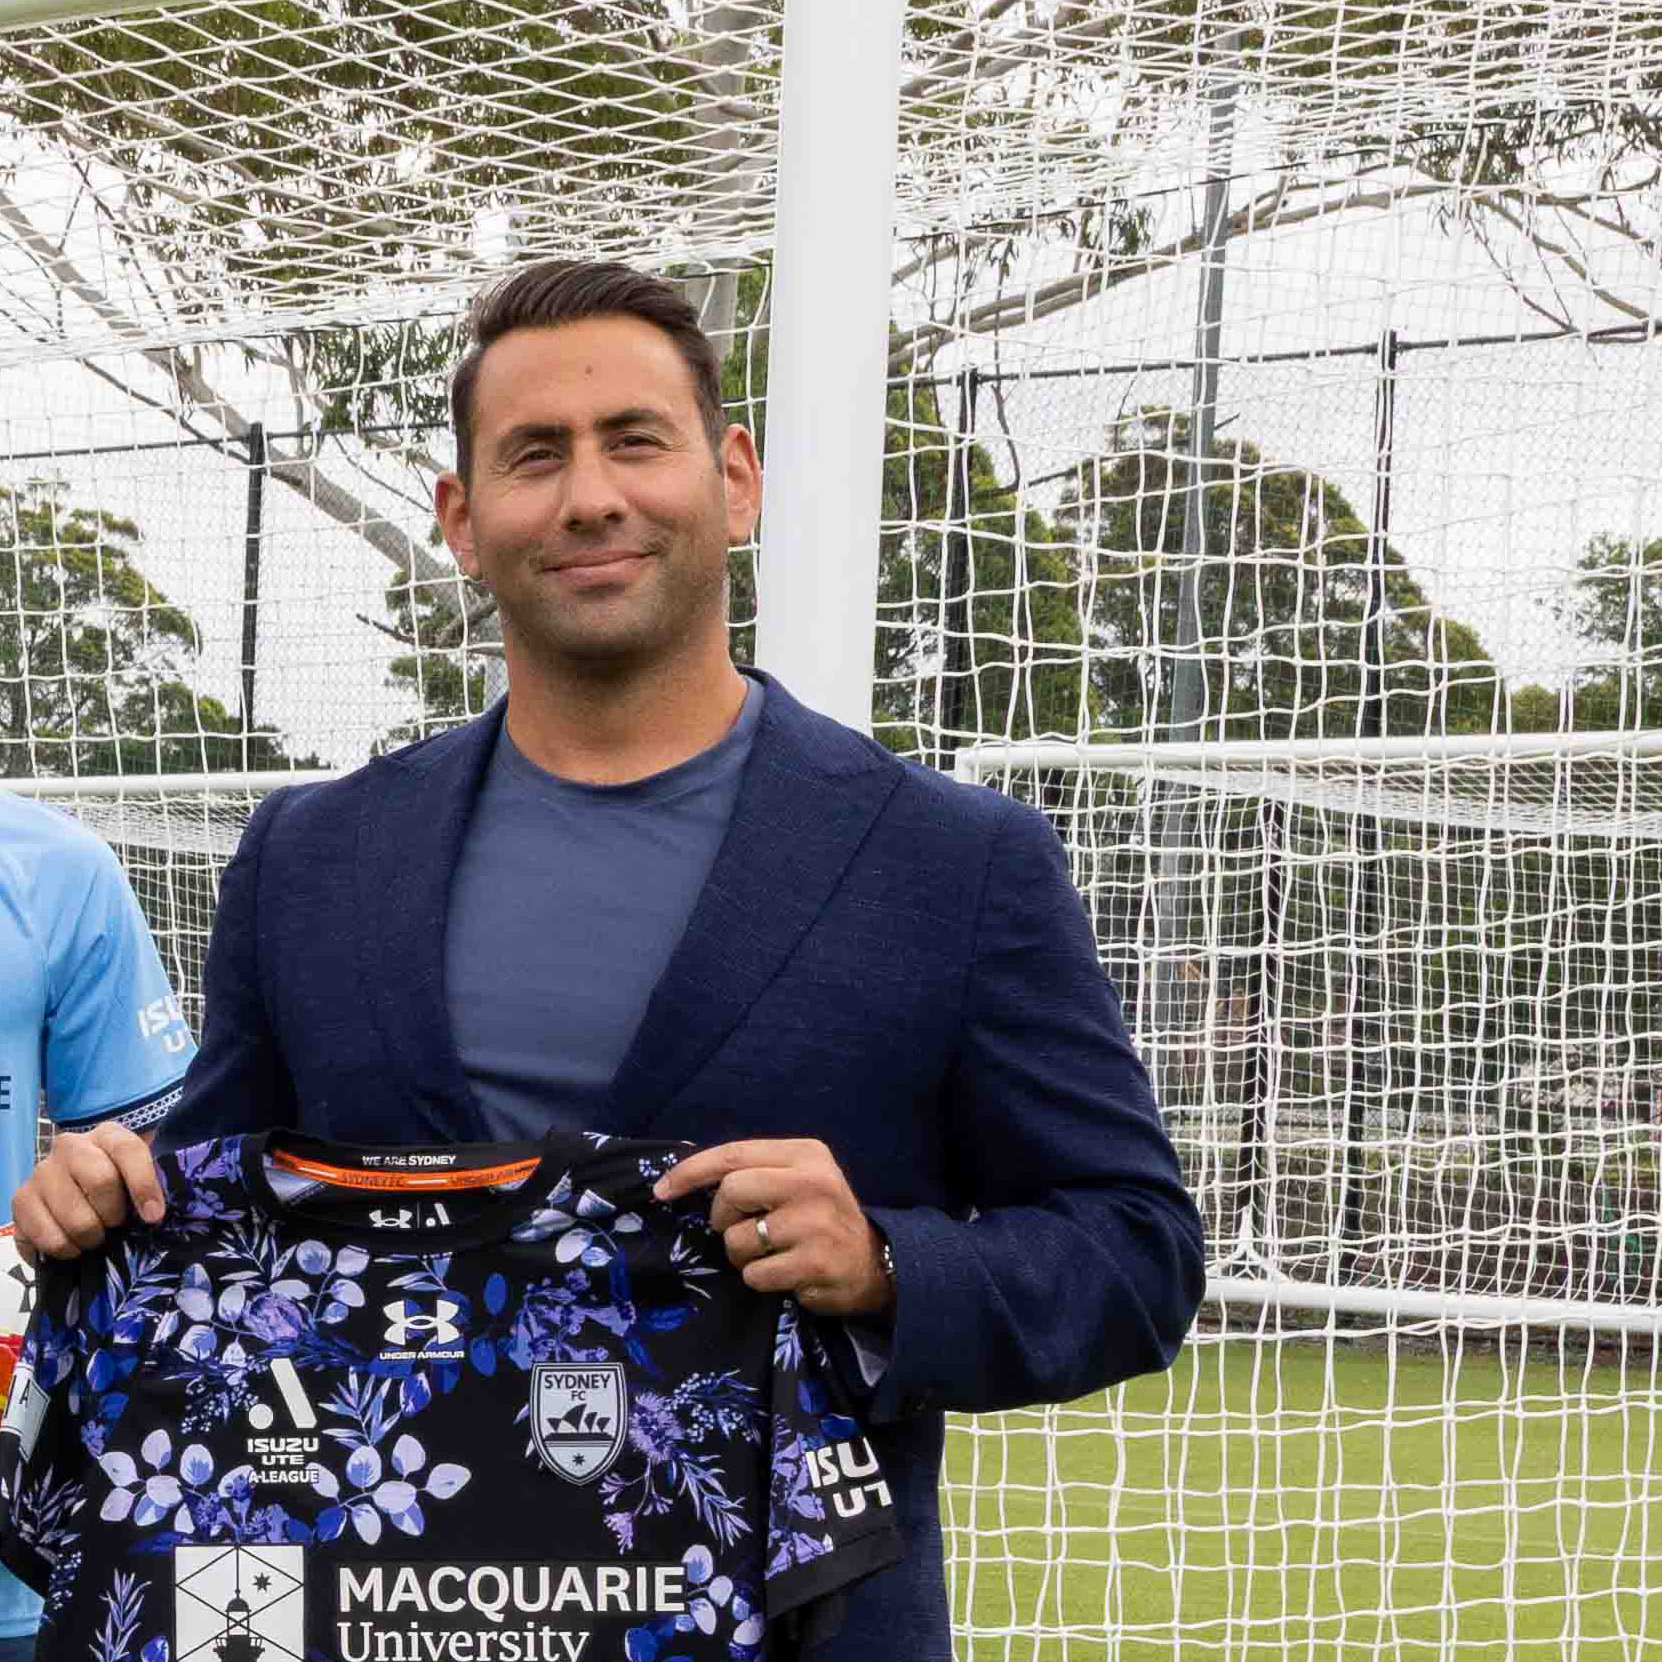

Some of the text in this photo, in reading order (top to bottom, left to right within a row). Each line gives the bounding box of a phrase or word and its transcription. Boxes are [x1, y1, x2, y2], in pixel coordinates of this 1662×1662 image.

[362, 1155, 456, 1166] WE ARE SYDNEY
[379, 1350, 465, 1360] UNDER ARMOUR
[544, 1373, 611, 1389] SYDNEY
[571, 1390, 586, 1401] FC
[247, 1436, 319, 1453] ISUZU
[261, 1454, 305, 1466] UTE
[805, 1436, 880, 1488] ISU
[248, 1469, 319, 1484] A-LEAGUE
[833, 1480, 893, 1517] UT
[338, 1565, 687, 1623] MACQUARIE
